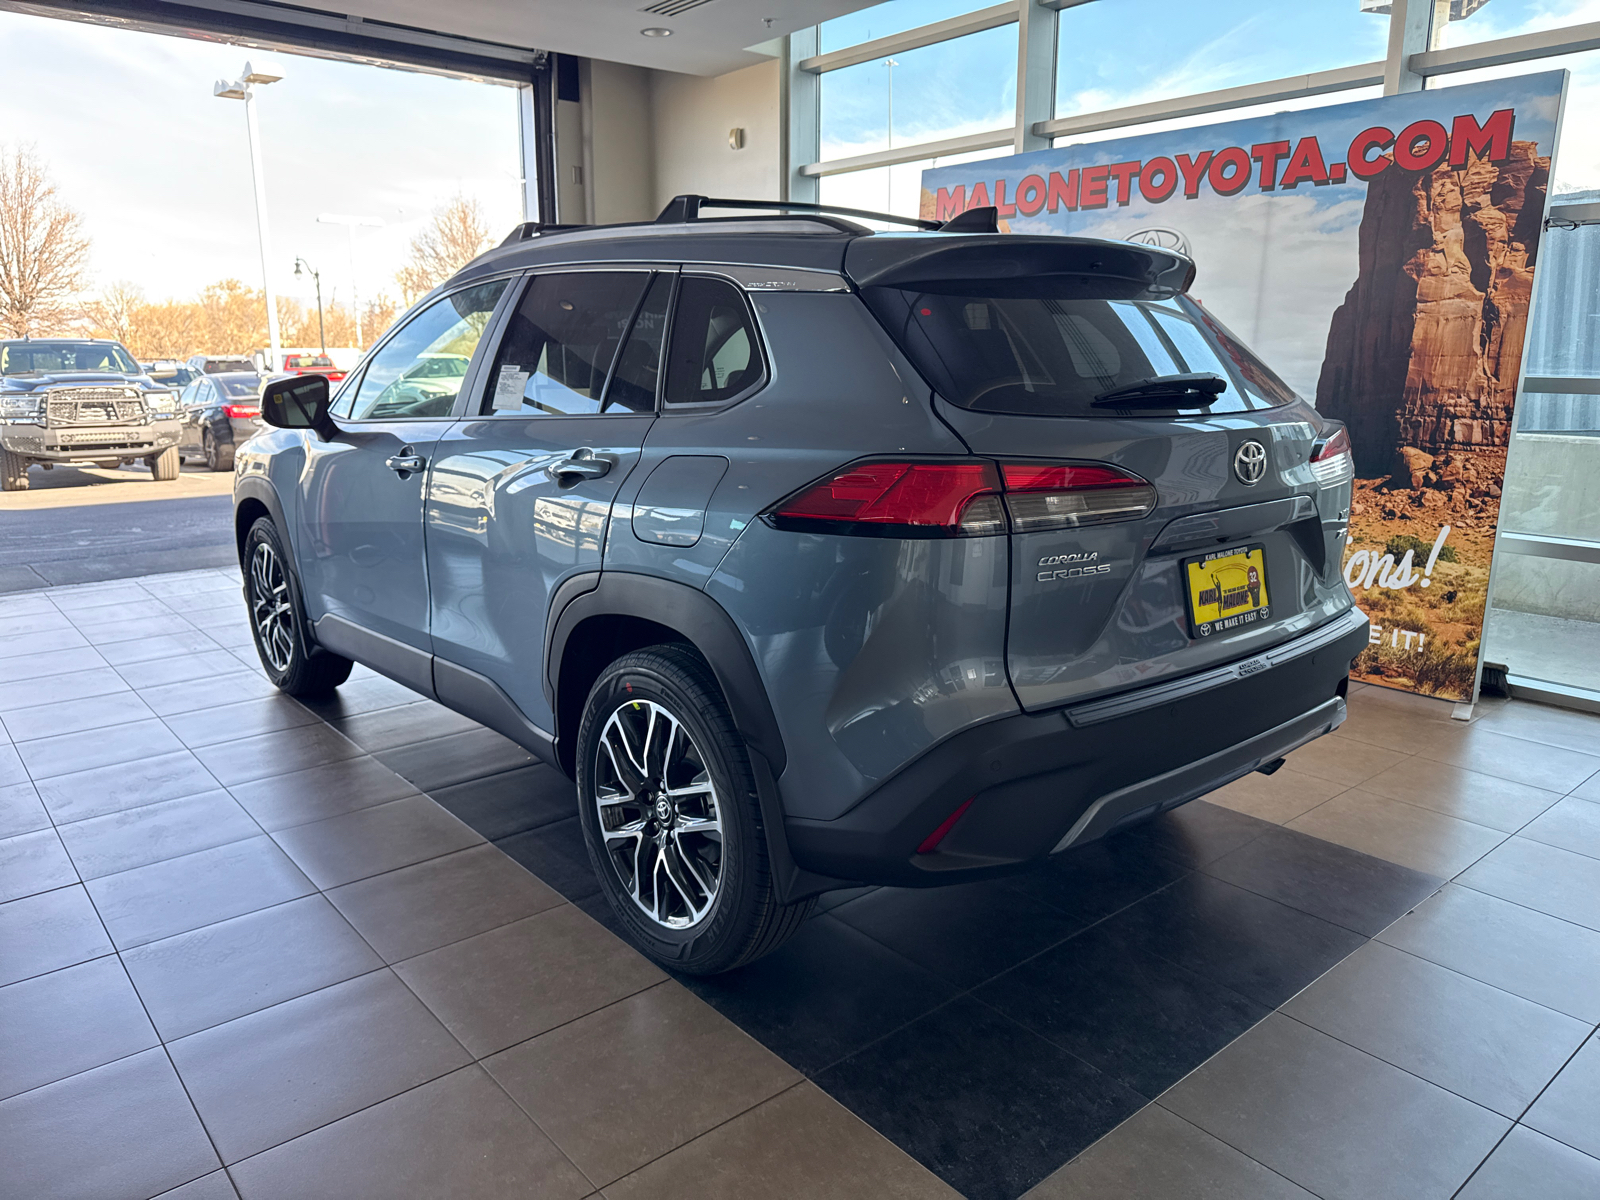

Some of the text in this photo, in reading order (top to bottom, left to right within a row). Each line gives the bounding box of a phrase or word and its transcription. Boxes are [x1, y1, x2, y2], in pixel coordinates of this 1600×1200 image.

[935, 108, 1516, 220] MALONETOYOTA.COM
[1038, 551, 1098, 566] COROLLA
[1205, 553, 1217, 561] KARL
[1217, 550, 1234, 559] MALONE
[1343, 525, 1450, 589] ons!
[1037, 563, 1111, 582] CROSS
[1249, 571, 1257, 583] 32
[1199, 588, 1218, 607] KARL
[1223, 590, 1249, 610] MALONE
[1215, 621, 1224, 631] WE
[1224, 617, 1239, 629] MAKE
[1244, 612, 1257, 623] EASY
[1391, 628, 1426, 653] IT!
